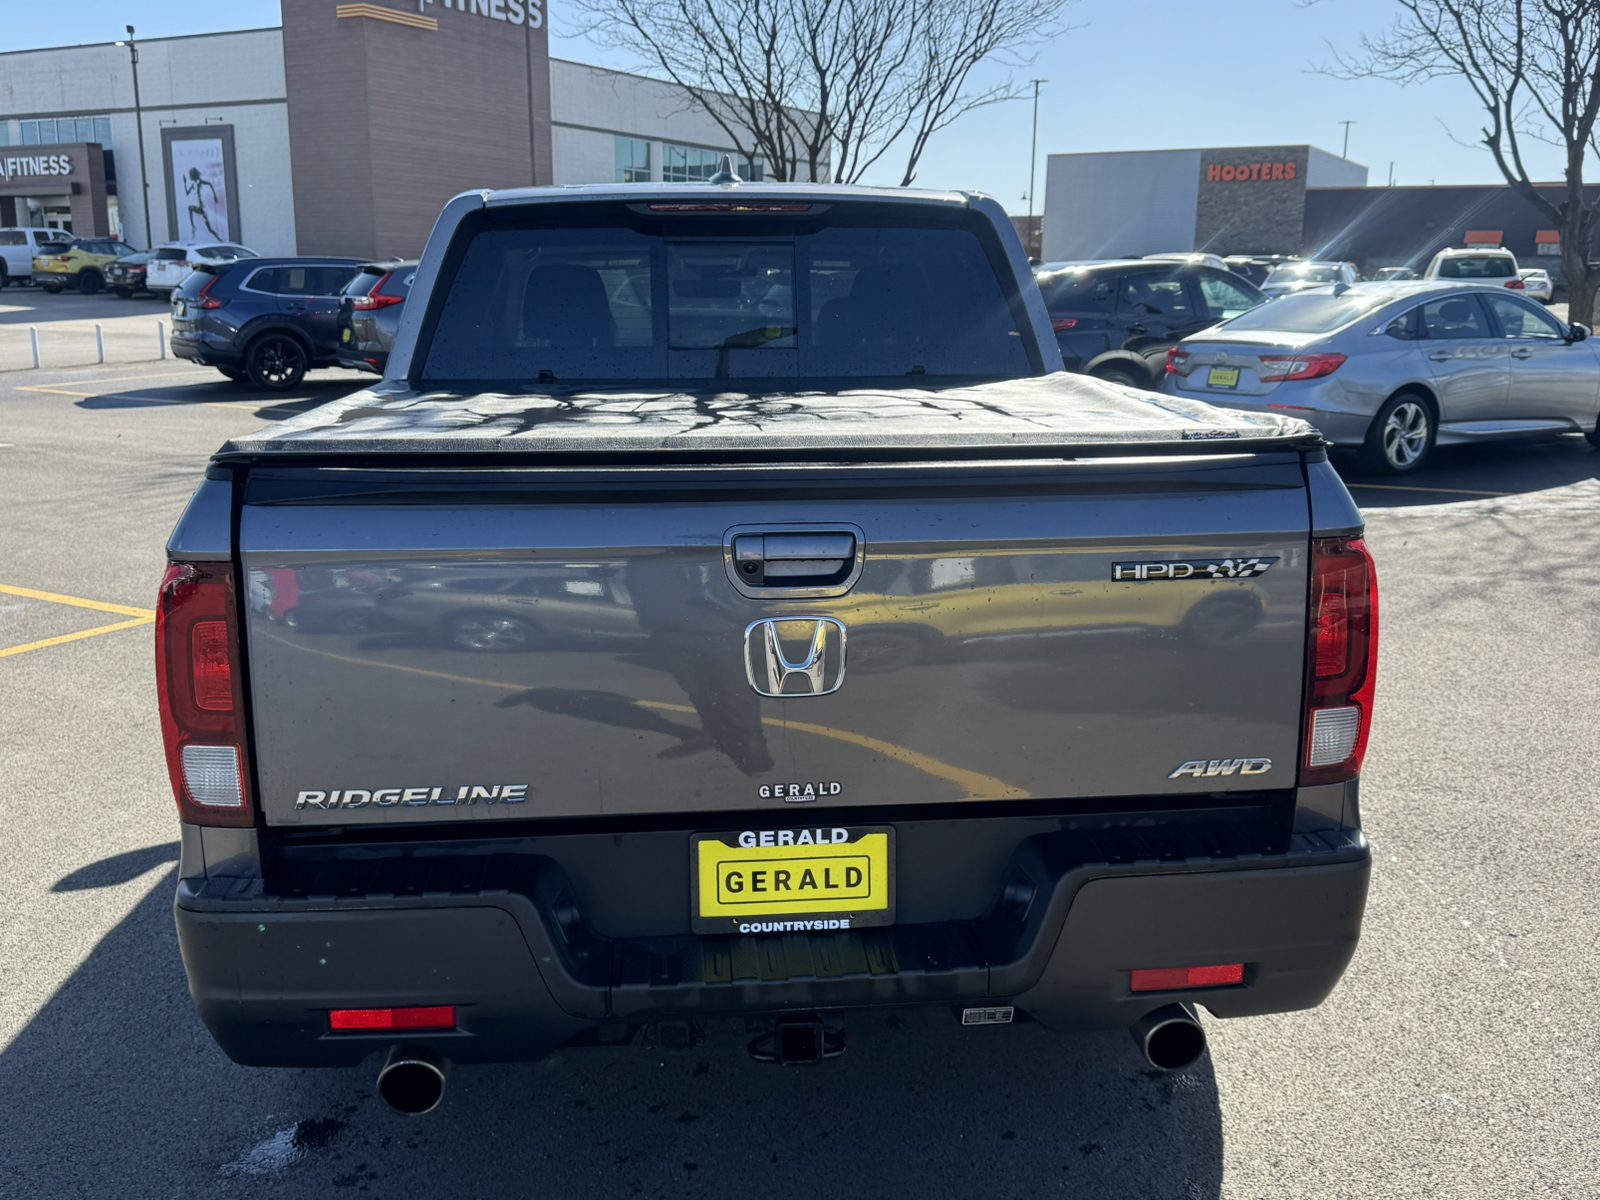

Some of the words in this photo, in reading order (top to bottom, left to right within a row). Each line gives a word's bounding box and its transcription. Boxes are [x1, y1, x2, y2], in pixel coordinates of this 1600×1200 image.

[426, 0, 543, 29] NESS
[1207, 162, 1296, 182] HOOTERS
[1115, 563, 1195, 580] HPD
[1168, 758, 1273, 779] AWD
[295, 784, 529, 810] RIDGELINE
[758, 782, 842, 798] GERALD
[738, 828, 849, 849] GERALD
[725, 866, 863, 894] GERALD
[739, 919, 850, 934] COUNTRYSIDE
